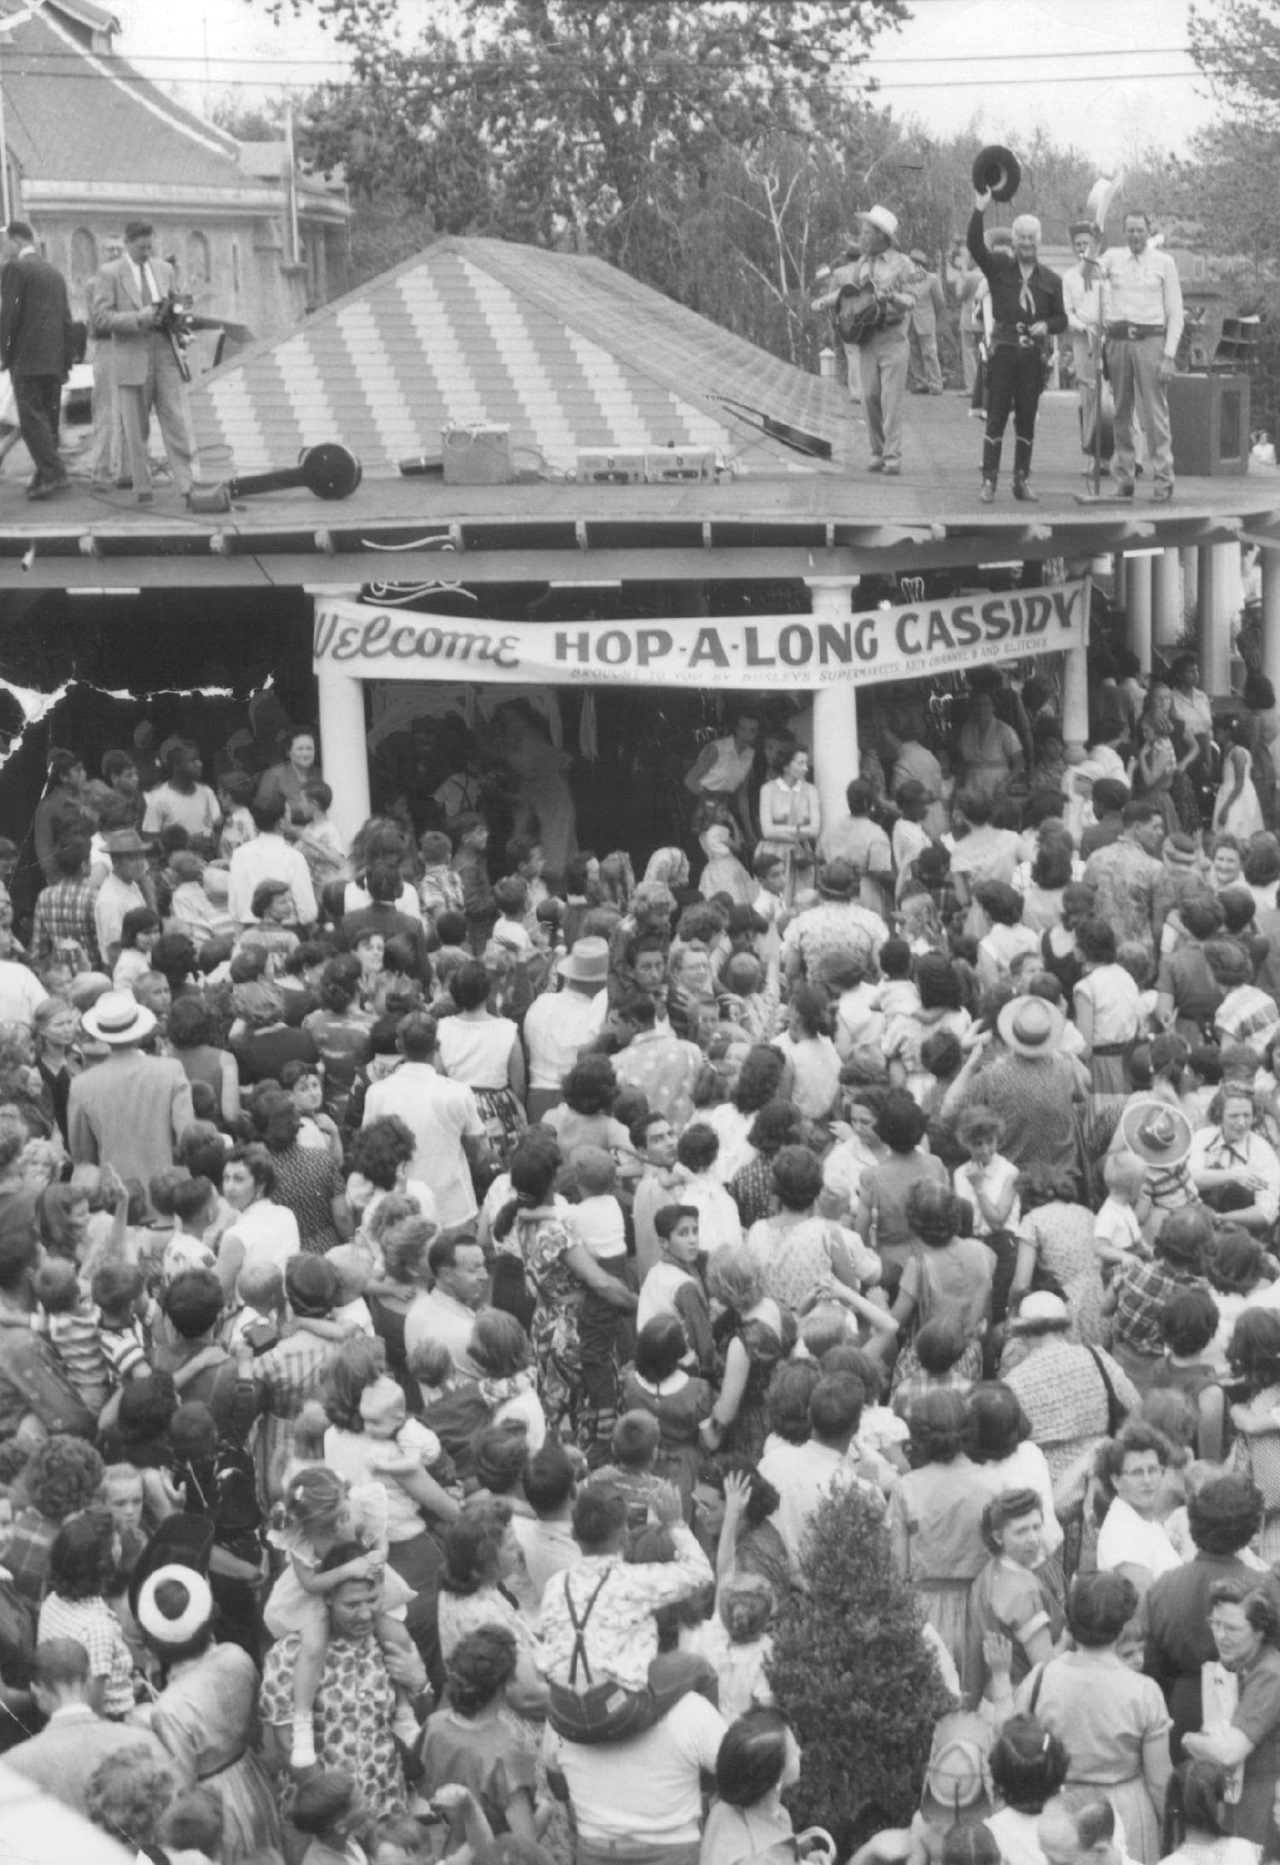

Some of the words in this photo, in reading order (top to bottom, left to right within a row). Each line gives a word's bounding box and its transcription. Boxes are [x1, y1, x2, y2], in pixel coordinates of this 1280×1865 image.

[895, 588, 1081, 656] CASSIDY
[570, 668, 639, 681] BROUGHT
[651, 669, 666, 681] TO
[674, 670, 702, 682] YOU
[712, 671, 732, 682] BY
[928, 651, 968, 667] CHANNEL
[981, 644, 1000, 656] AND
